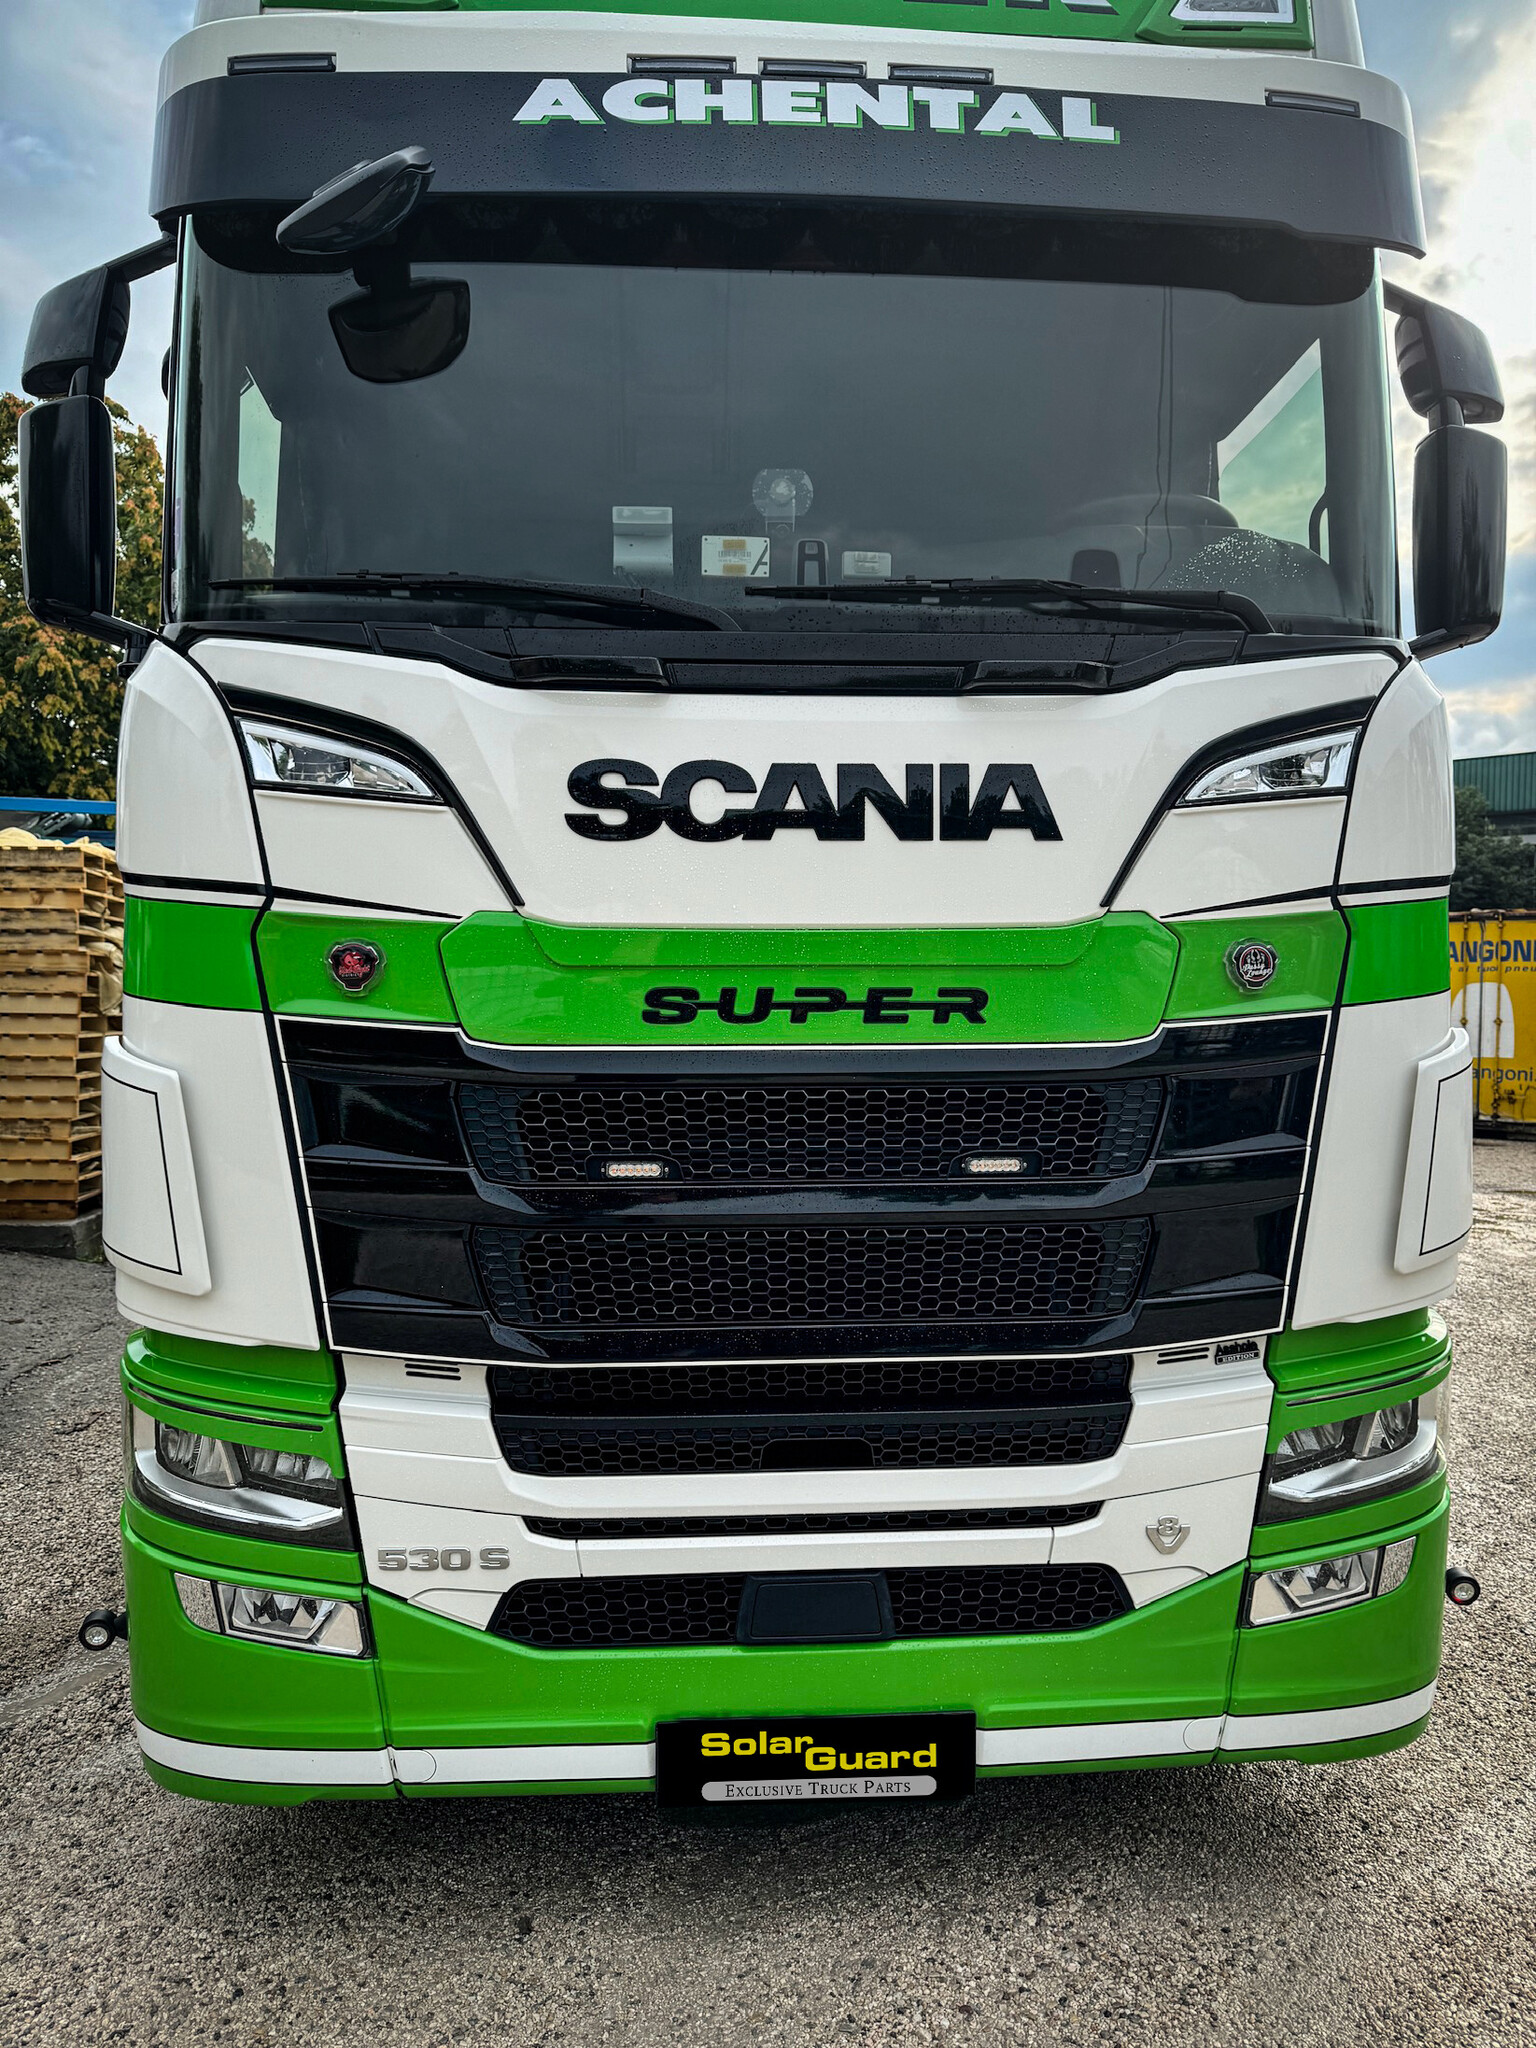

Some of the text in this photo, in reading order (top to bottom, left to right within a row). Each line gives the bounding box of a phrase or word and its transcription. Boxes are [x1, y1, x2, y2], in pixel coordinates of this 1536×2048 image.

[512, 78, 1120, 144] ACHENTAL
[564, 758, 1063, 842] SCANIA
[641, 986, 989, 1025] SUPER
[1222, 1352, 1255, 1363] EDITION
[378, 1545, 510, 1571] 530 S
